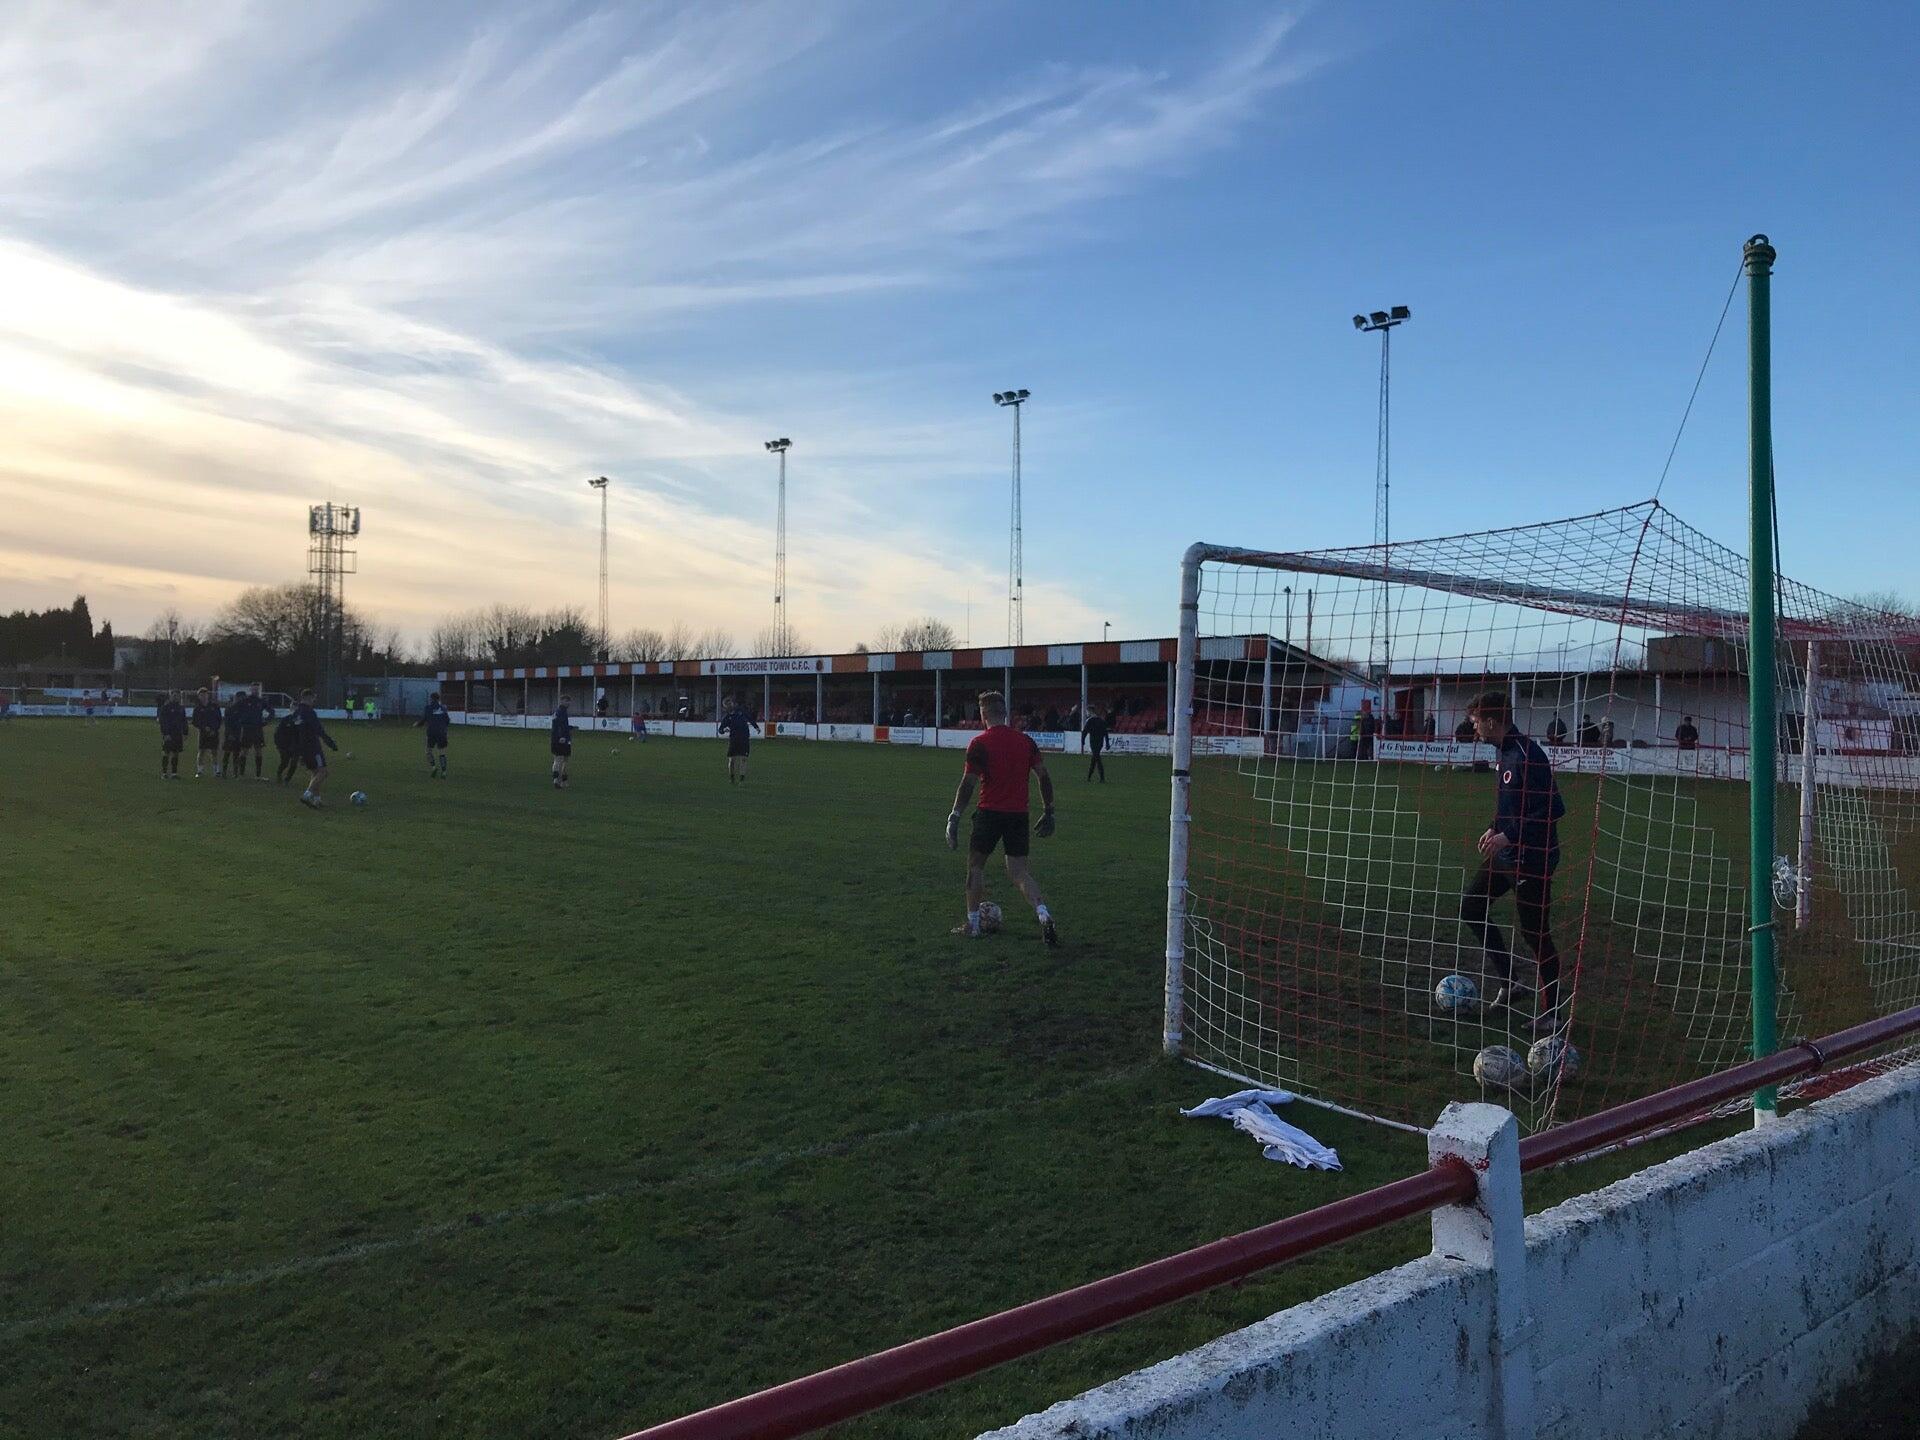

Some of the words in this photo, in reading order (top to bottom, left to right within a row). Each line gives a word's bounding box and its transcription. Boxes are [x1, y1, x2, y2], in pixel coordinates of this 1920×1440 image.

[723, 661, 768, 672] ATHERSTONE
[769, 661, 791, 672] TOWN
[1394, 743, 1416, 752] Evans
[1425, 744, 1444, 753] Sons
